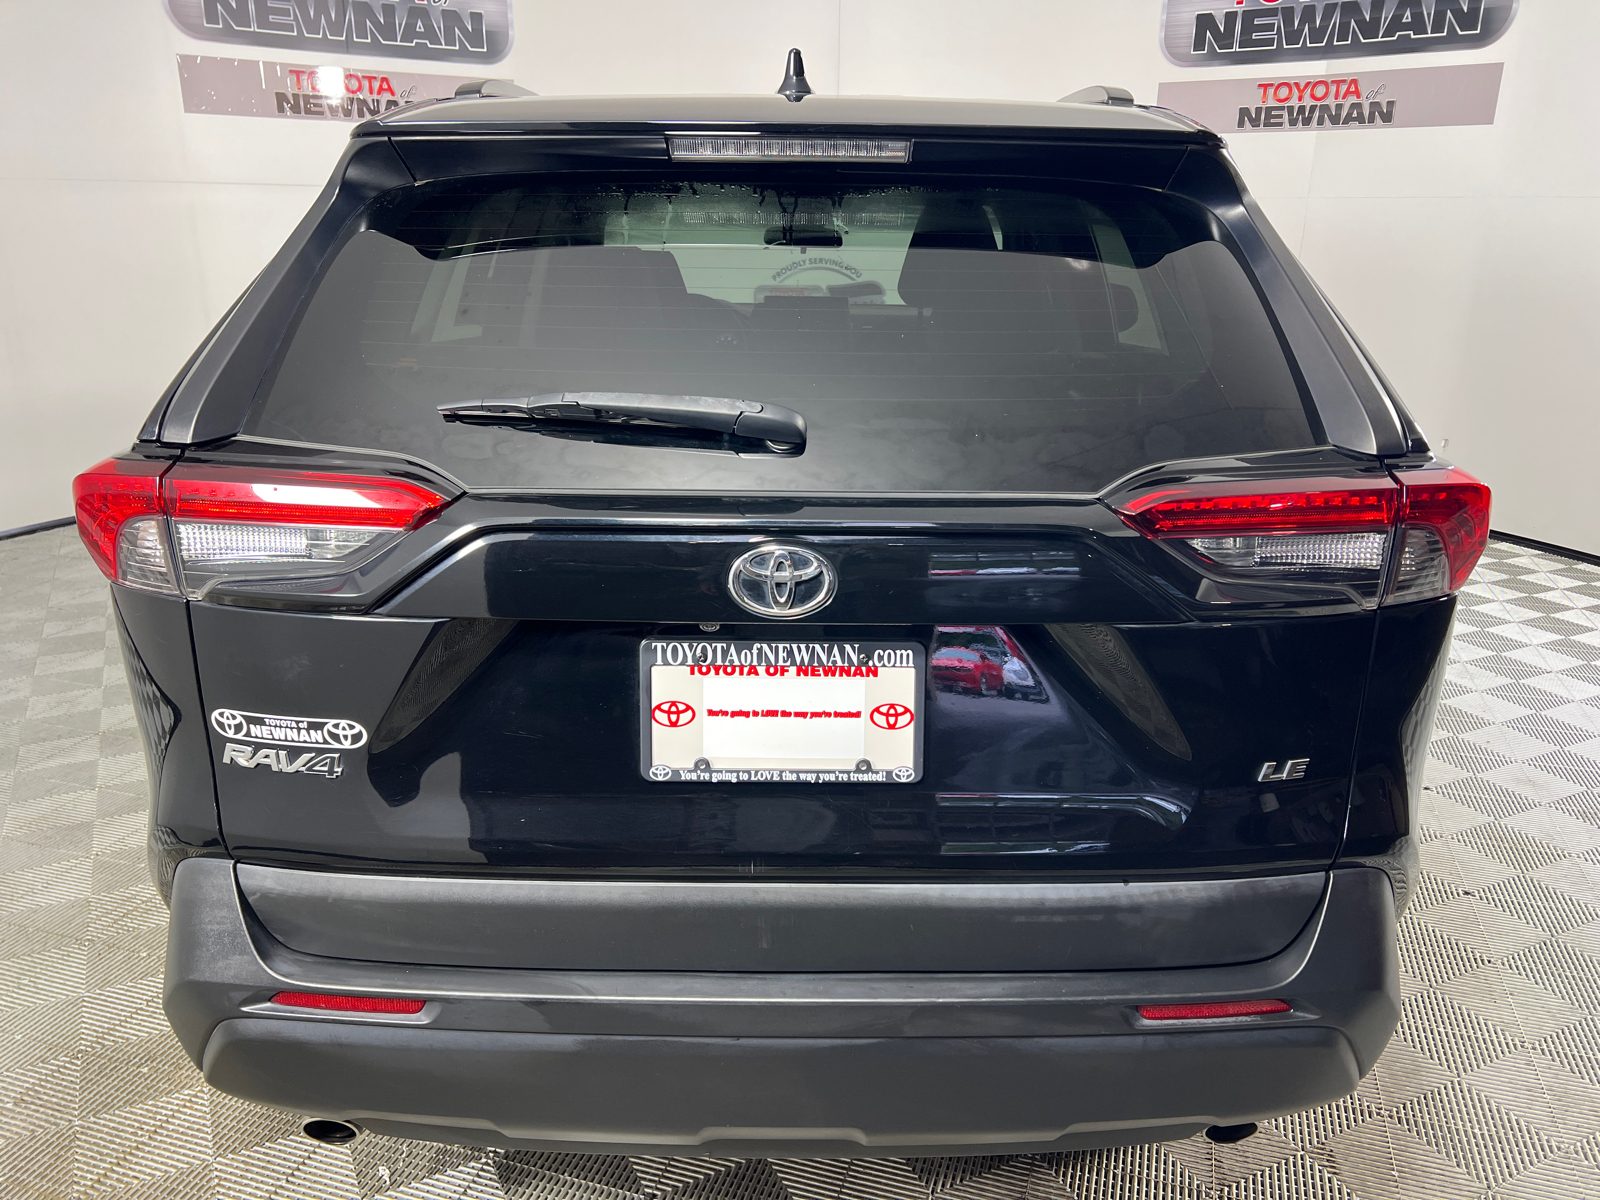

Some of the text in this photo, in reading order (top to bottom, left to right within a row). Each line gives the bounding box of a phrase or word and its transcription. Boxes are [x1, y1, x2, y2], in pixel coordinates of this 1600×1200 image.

[203, 0, 487, 51] NEWNAN
[1191, 0, 1484, 53] NEWNAN
[288, 69, 395, 97] TOOTA
[1257, 78, 1362, 104] TOYOTA
[274, 91, 413, 119] NEWN
[1236, 99, 1396, 129] NEWNAN
[771, 259, 807, 281] PROUDLY
[808, 257, 844, 269] SERVING
[689, 664, 879, 678] TOYOTA OF NEWNAN
[264, 718, 297, 728] TOYOTA
[751, 709, 760, 717] to
[249, 724, 324, 743] NEWNAN
[222, 742, 345, 779] RAV4
[1257, 758, 1311, 782] LE
[711, 770, 737, 783] going
[738, 771, 749, 781] to
[750, 771, 780, 781] LOVE
[782, 771, 797, 781] the
[799, 773, 818, 783] way
[850, 772, 886, 782] treated!
